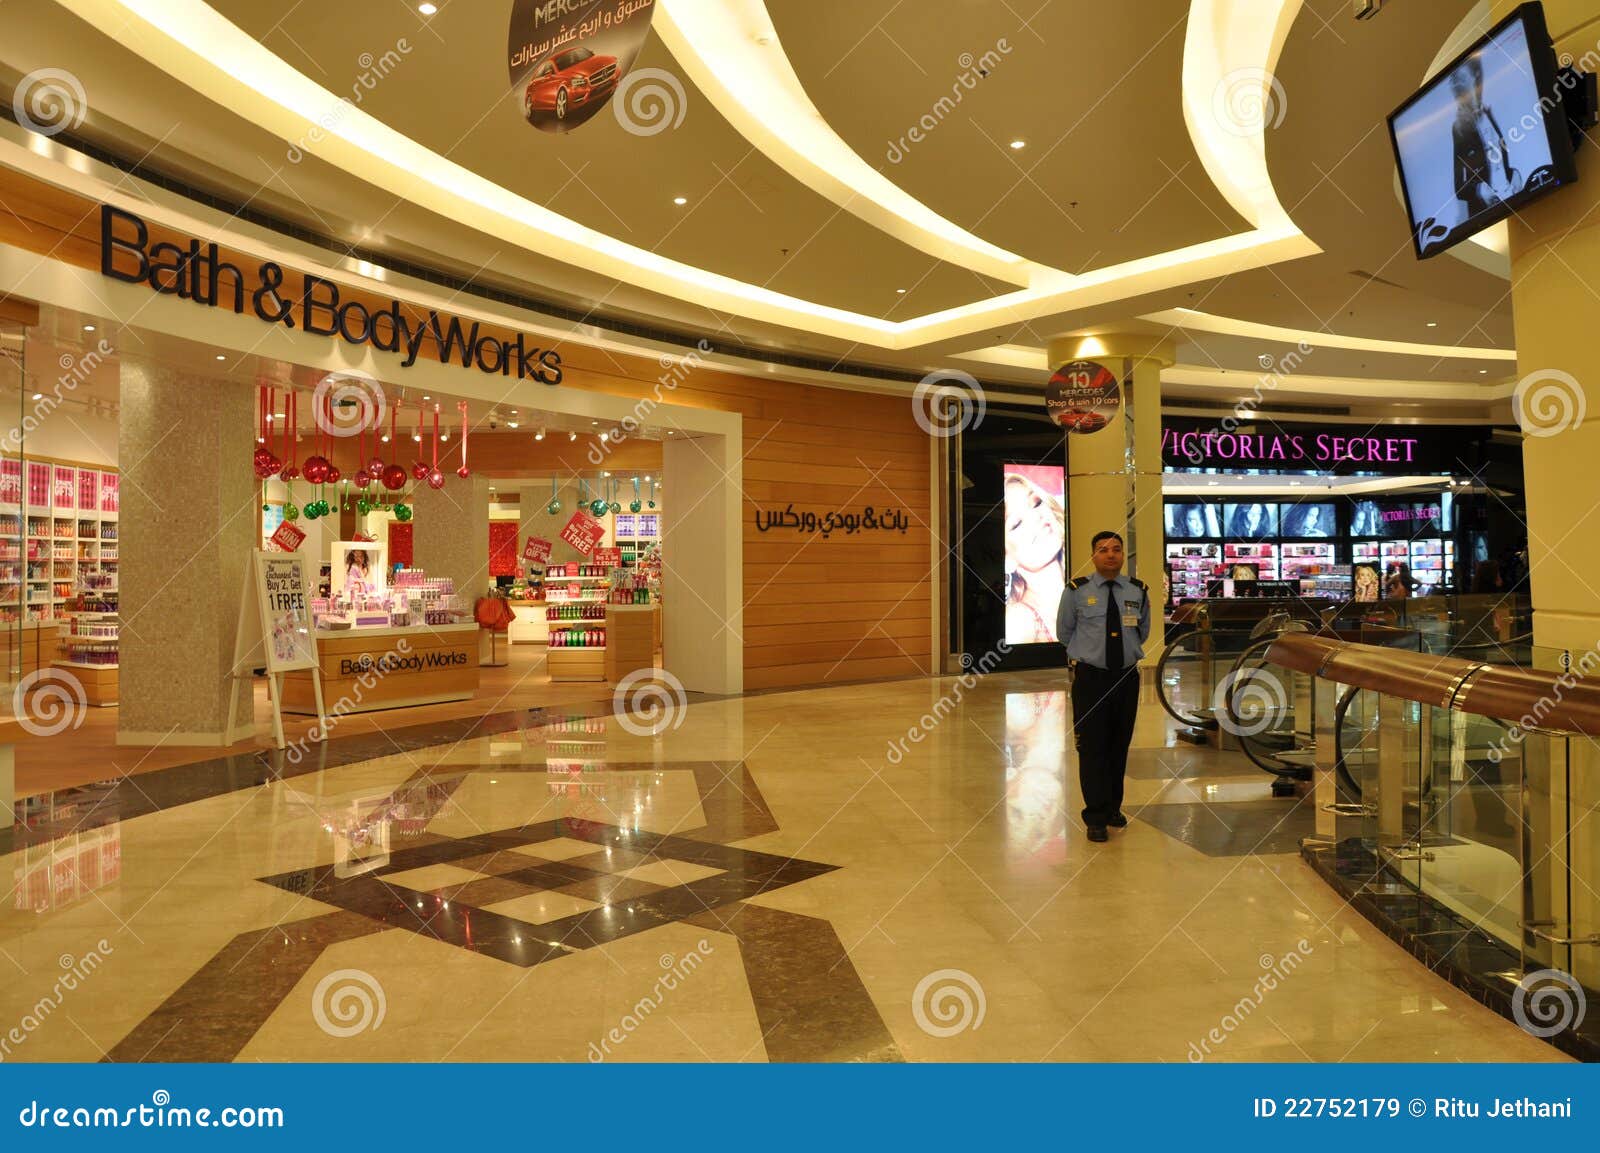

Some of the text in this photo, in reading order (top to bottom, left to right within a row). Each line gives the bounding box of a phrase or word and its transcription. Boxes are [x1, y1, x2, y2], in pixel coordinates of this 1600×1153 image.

[535, 0, 594, 29] MERC
[101, 204, 562, 385] Bath & Body Works
[1068, 371, 1090, 389] 10
[1060, 387, 1105, 398] MERCEDES
[1047, 399, 1067, 408] Shop
[1092, 397, 1102, 405] 10
[1316, 434, 1418, 462] SECRET
[267, 579, 280, 592] Buy
[269, 592, 304, 611] 1 FREE
[391, 654, 424, 672] Body
[425, 651, 467, 667] Works
